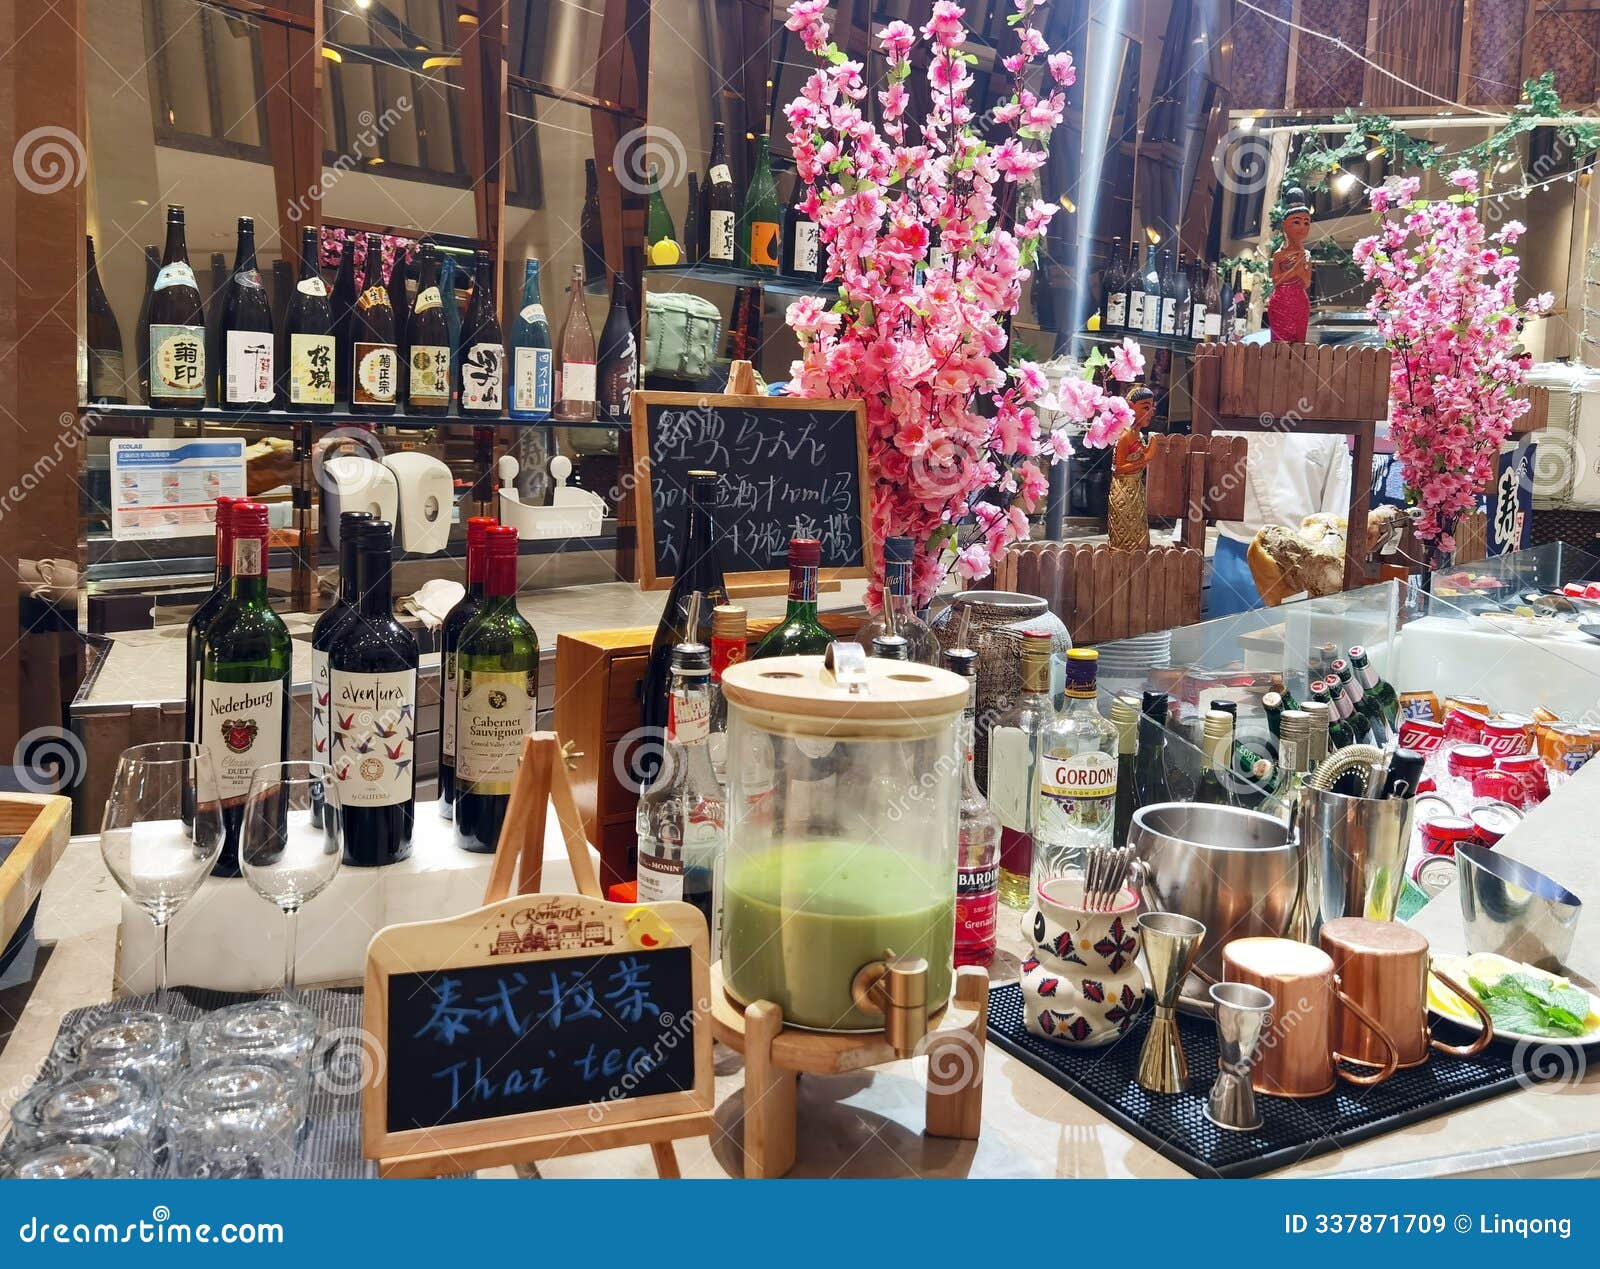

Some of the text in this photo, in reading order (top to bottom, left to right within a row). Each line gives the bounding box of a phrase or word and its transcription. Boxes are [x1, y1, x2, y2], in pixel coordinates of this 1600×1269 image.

[378, 353, 391, 394] 菊正宗
[210, 691, 273, 716] Nederburg
[342, 678, 404, 712] aventura
[472, 715, 521, 728] Cabernet
[469, 726, 523, 740] Sauvignon
[651, 861, 680, 873] MONIN
